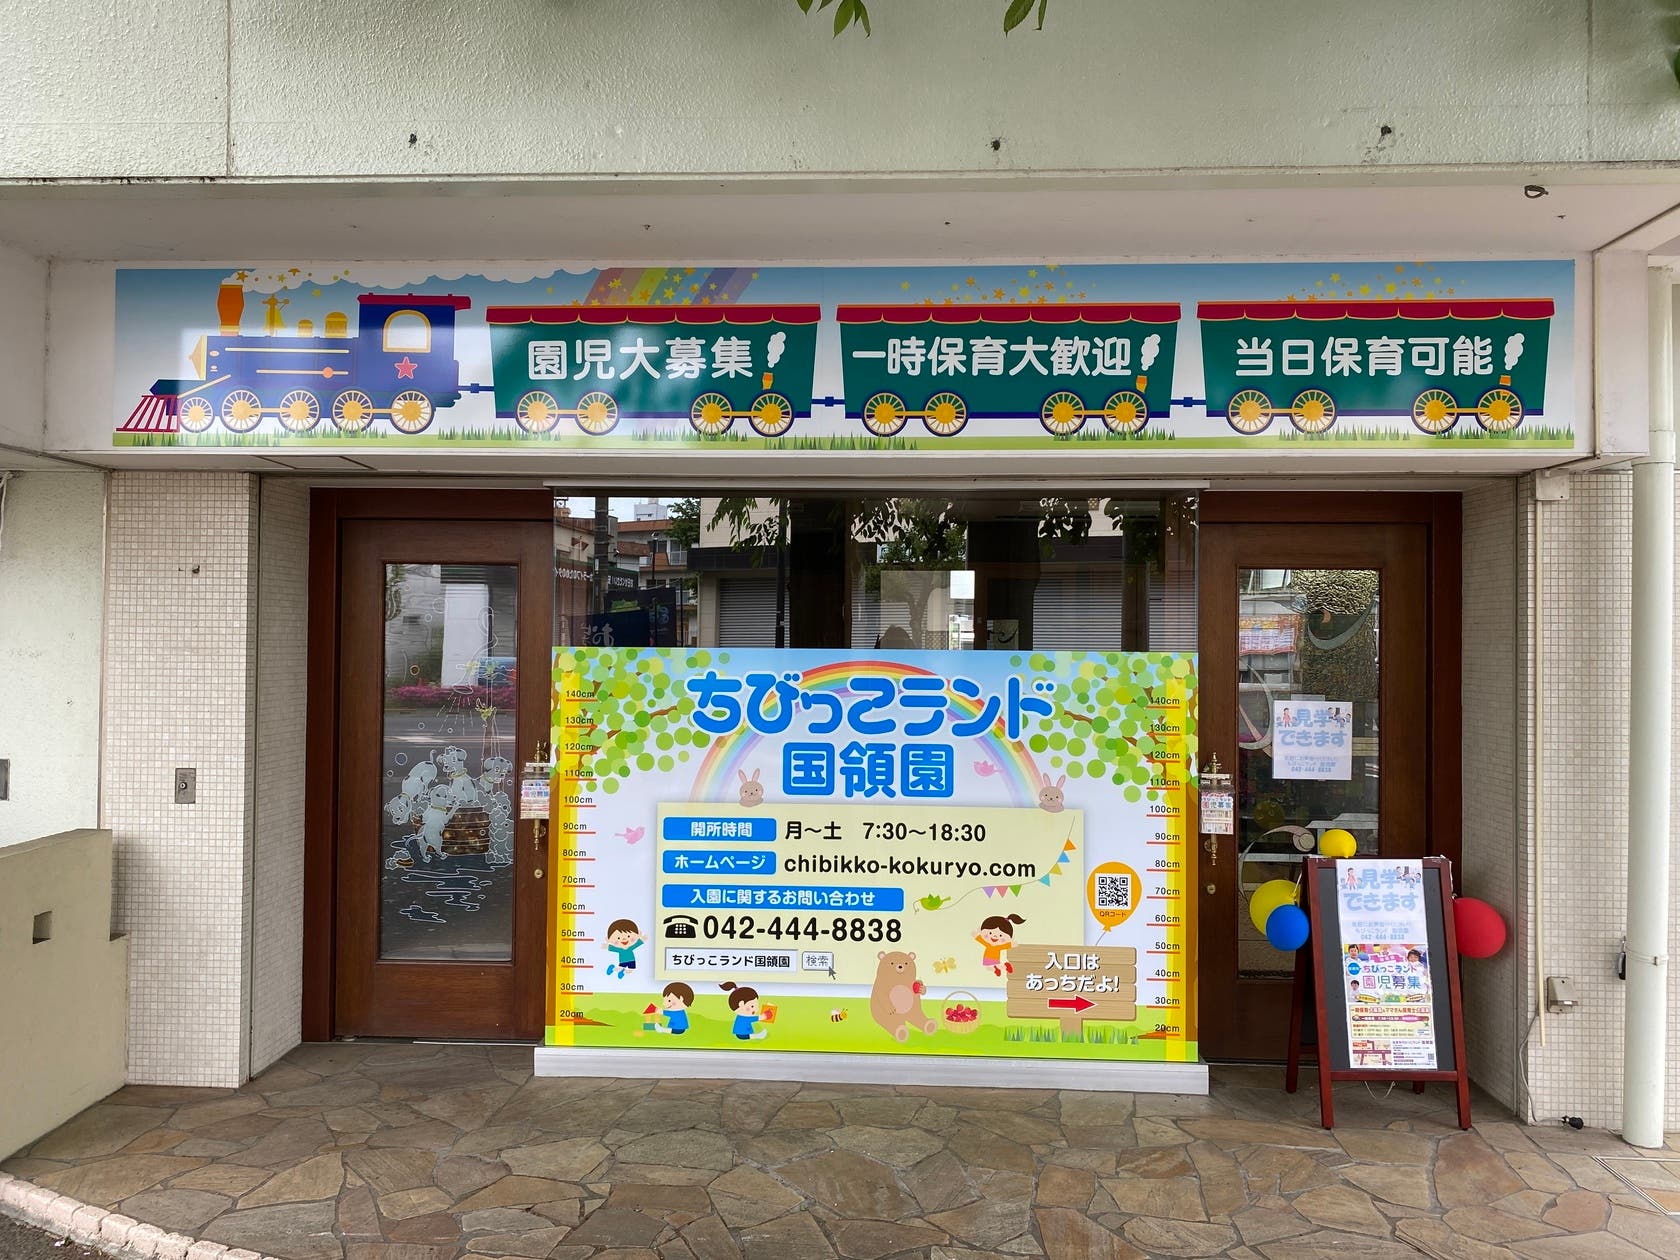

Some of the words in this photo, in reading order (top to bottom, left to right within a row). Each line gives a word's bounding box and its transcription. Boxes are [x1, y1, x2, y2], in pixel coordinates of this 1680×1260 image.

[528, 336, 753, 380] 園児大募集
[852, 334, 1131, 376] 一時保育大歓迎
[1235, 335, 1493, 377] 当日保育可能
[565, 689, 594, 699] 140cm
[687, 669, 1054, 740] ちびっこランド
[1150, 696, 1180, 706] 140cm
[565, 716, 594, 725] 130cm
[1296, 708, 1331, 728] 見学
[1149, 723, 1180, 733] 130cm
[1278, 729, 1348, 748] できます
[564, 742, 594, 752] 120cm
[1149, 750, 1180, 760] 120cm
[564, 769, 593, 778] 110cm
[782, 740, 954, 799] 国領園
[1149, 778, 1180, 787] 110cm
[563, 795, 593, 804] 100cm
[1149, 805, 1180, 814] 100cm
[563, 822, 587, 831] 90cm
[690, 820, 752, 838] 開所時間
[1155, 832, 1180, 841] 90cm
[562, 849, 587, 857] 80cm
[674, 854, 767, 871] ホームページ
[784, 855, 1036, 878] chibikko-kokuryo.com
[1155, 859, 1180, 868] 80cm
[562, 875, 586, 884] 70cm
[1362, 868, 1398, 890] 見学
[1155, 887, 1180, 896] 70cm
[690, 888, 876, 908] 入園に関するお問い合わせ
[1343, 892, 1419, 912] できます
[561, 902, 586, 911] 60cm
[1155, 914, 1180, 923] 60cm
[561, 929, 585, 938] 50cm
[703, 915, 902, 943] 042-444-8838
[1155, 941, 1180, 951] 50cm
[561, 955, 585, 964] 40cm
[671, 953, 791, 969] ちびっこランド国領園
[805, 954, 830, 967] 検索
[1044, 951, 1101, 971] 入口は
[1155, 969, 1180, 978] 40cm
[1363, 964, 1417, 974] ちびっこランド
[560, 982, 584, 991] 30cm
[1025, 974, 1120, 993] あっちだよ!
[1363, 975, 1421, 989] 園児募集
[1155, 996, 1180, 1006] 30cm
[1155, 1024, 1180, 1033] 20cm
